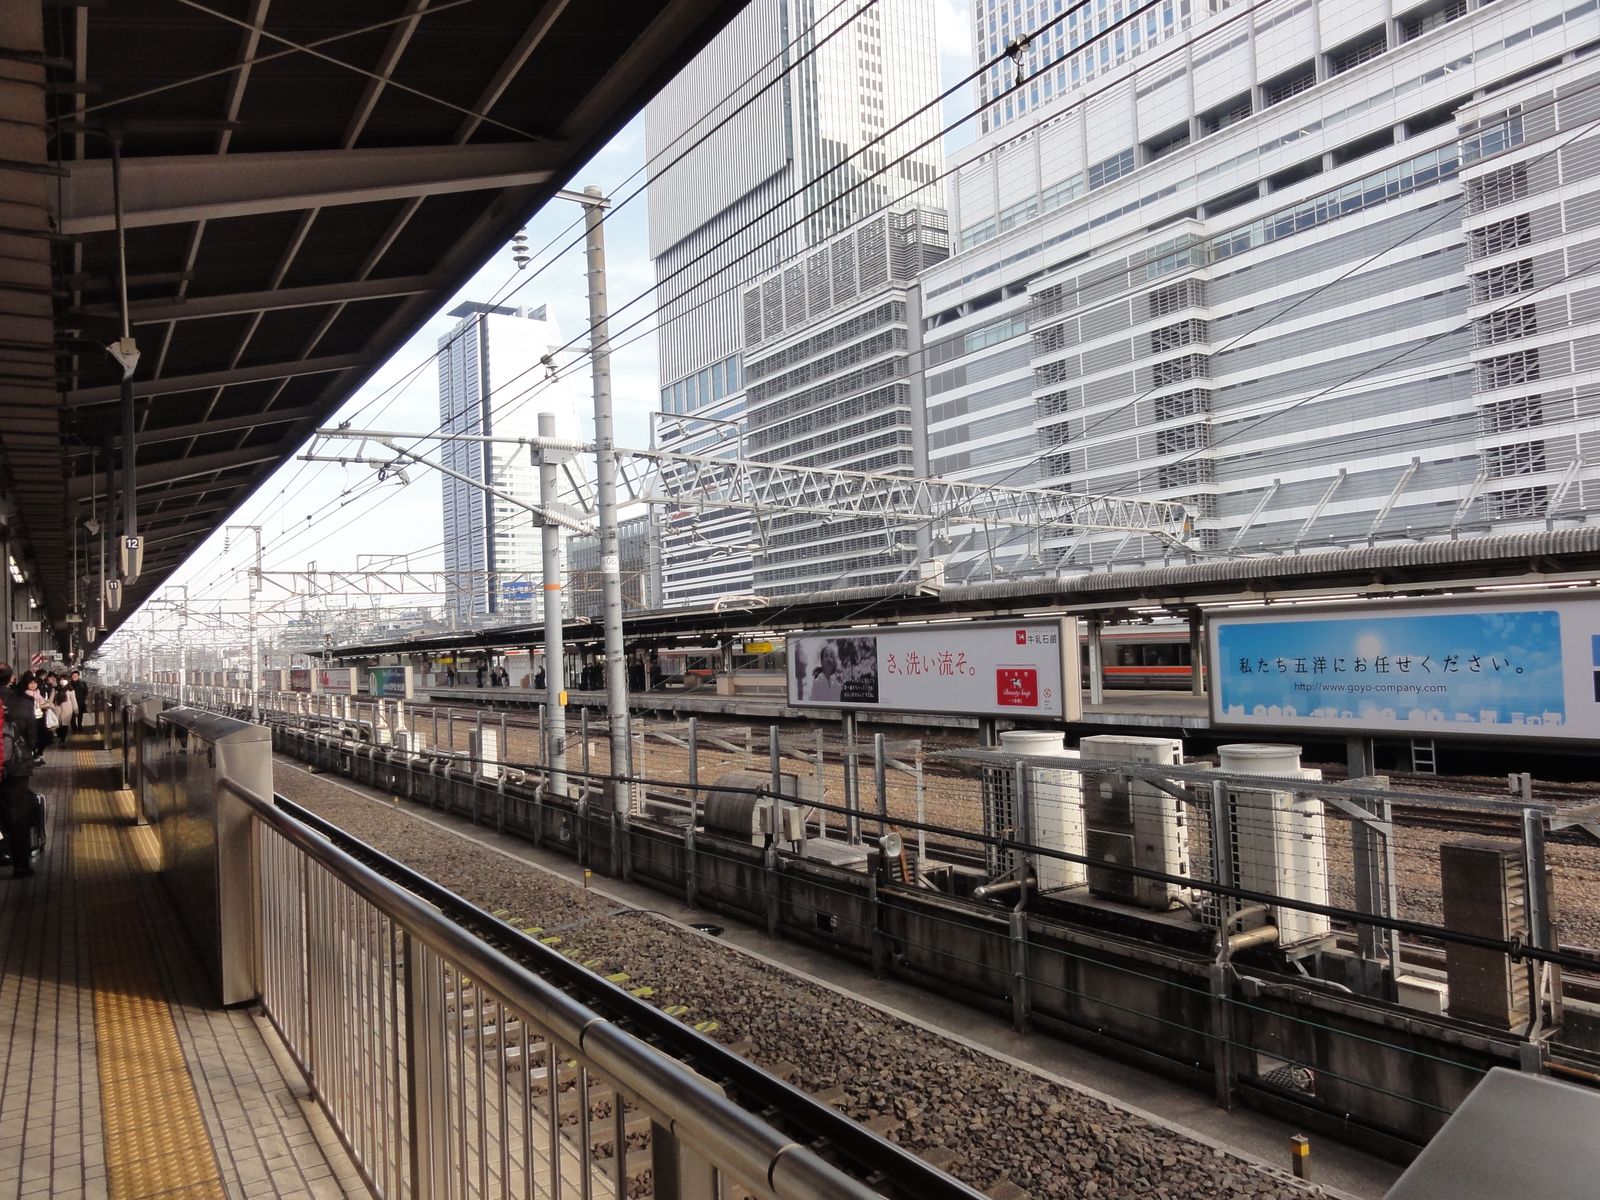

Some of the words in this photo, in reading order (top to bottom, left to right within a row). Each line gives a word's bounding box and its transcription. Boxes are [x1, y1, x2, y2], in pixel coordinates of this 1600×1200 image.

[127, 538, 138, 549] 12
[109, 582, 118, 590] 11
[887, 650, 976, 676] さ、洗い流そ。
[1239, 654, 1524, 674] 私たち五洋にお任せください。
[1294, 682, 1447, 694] http://www.goyo-company.com
